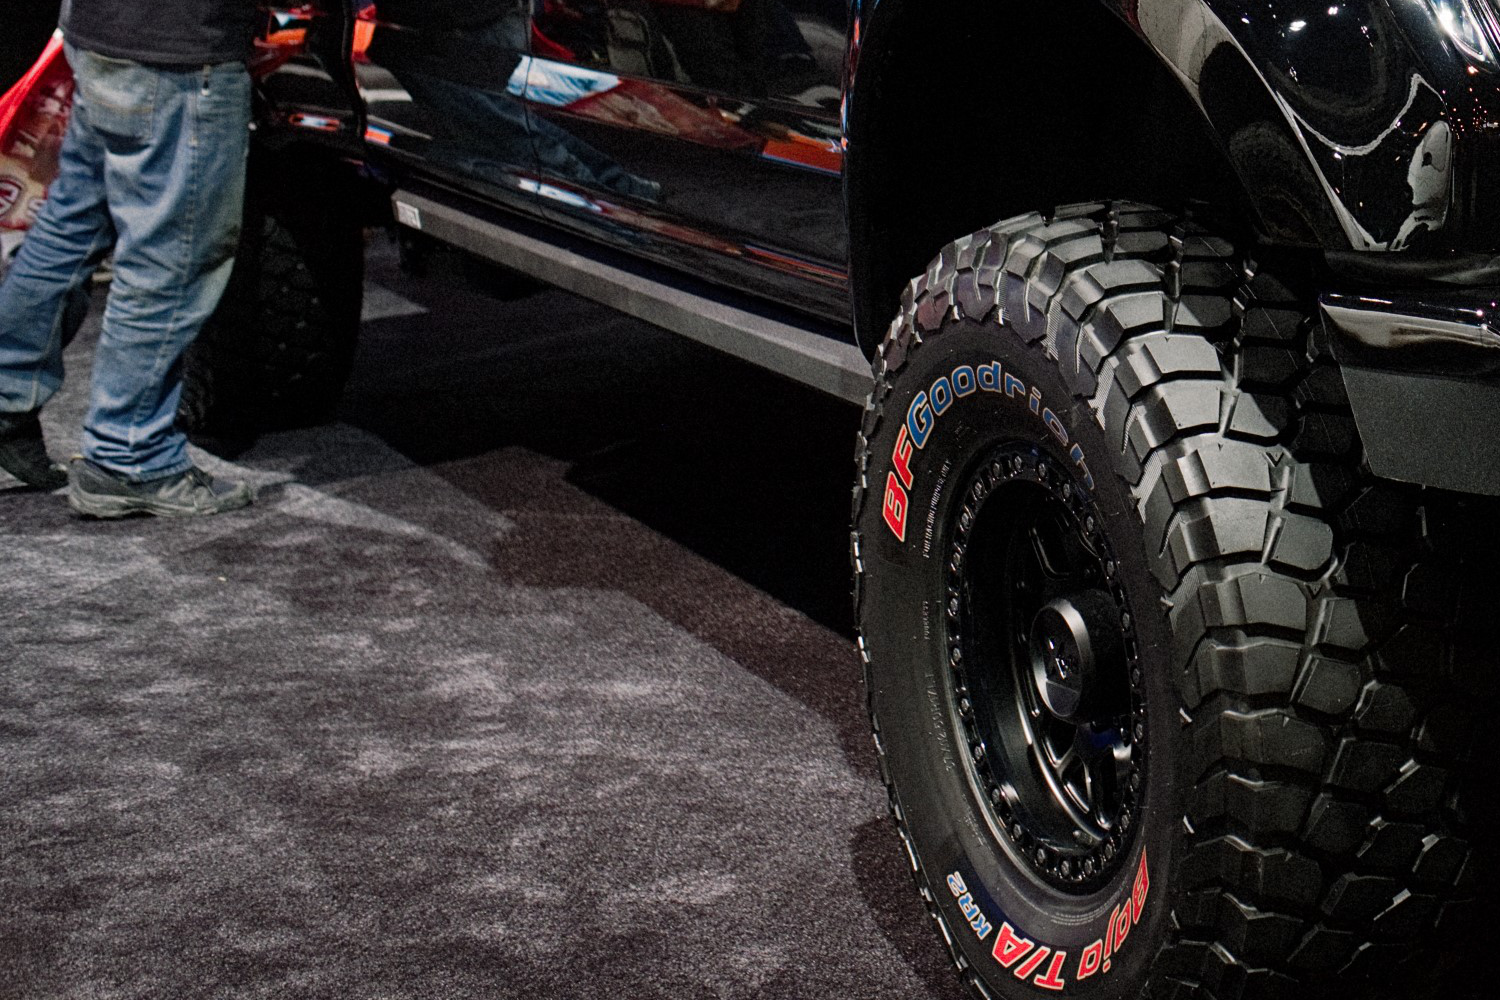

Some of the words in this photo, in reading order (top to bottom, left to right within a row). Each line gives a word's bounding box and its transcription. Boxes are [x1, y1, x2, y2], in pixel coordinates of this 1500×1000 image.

[883, 360, 1095, 542] BFGoodrich
[946, 870, 993, 940] KR2
[992, 921, 1067, 990] T/A
[1077, 845, 1150, 980] Baja
